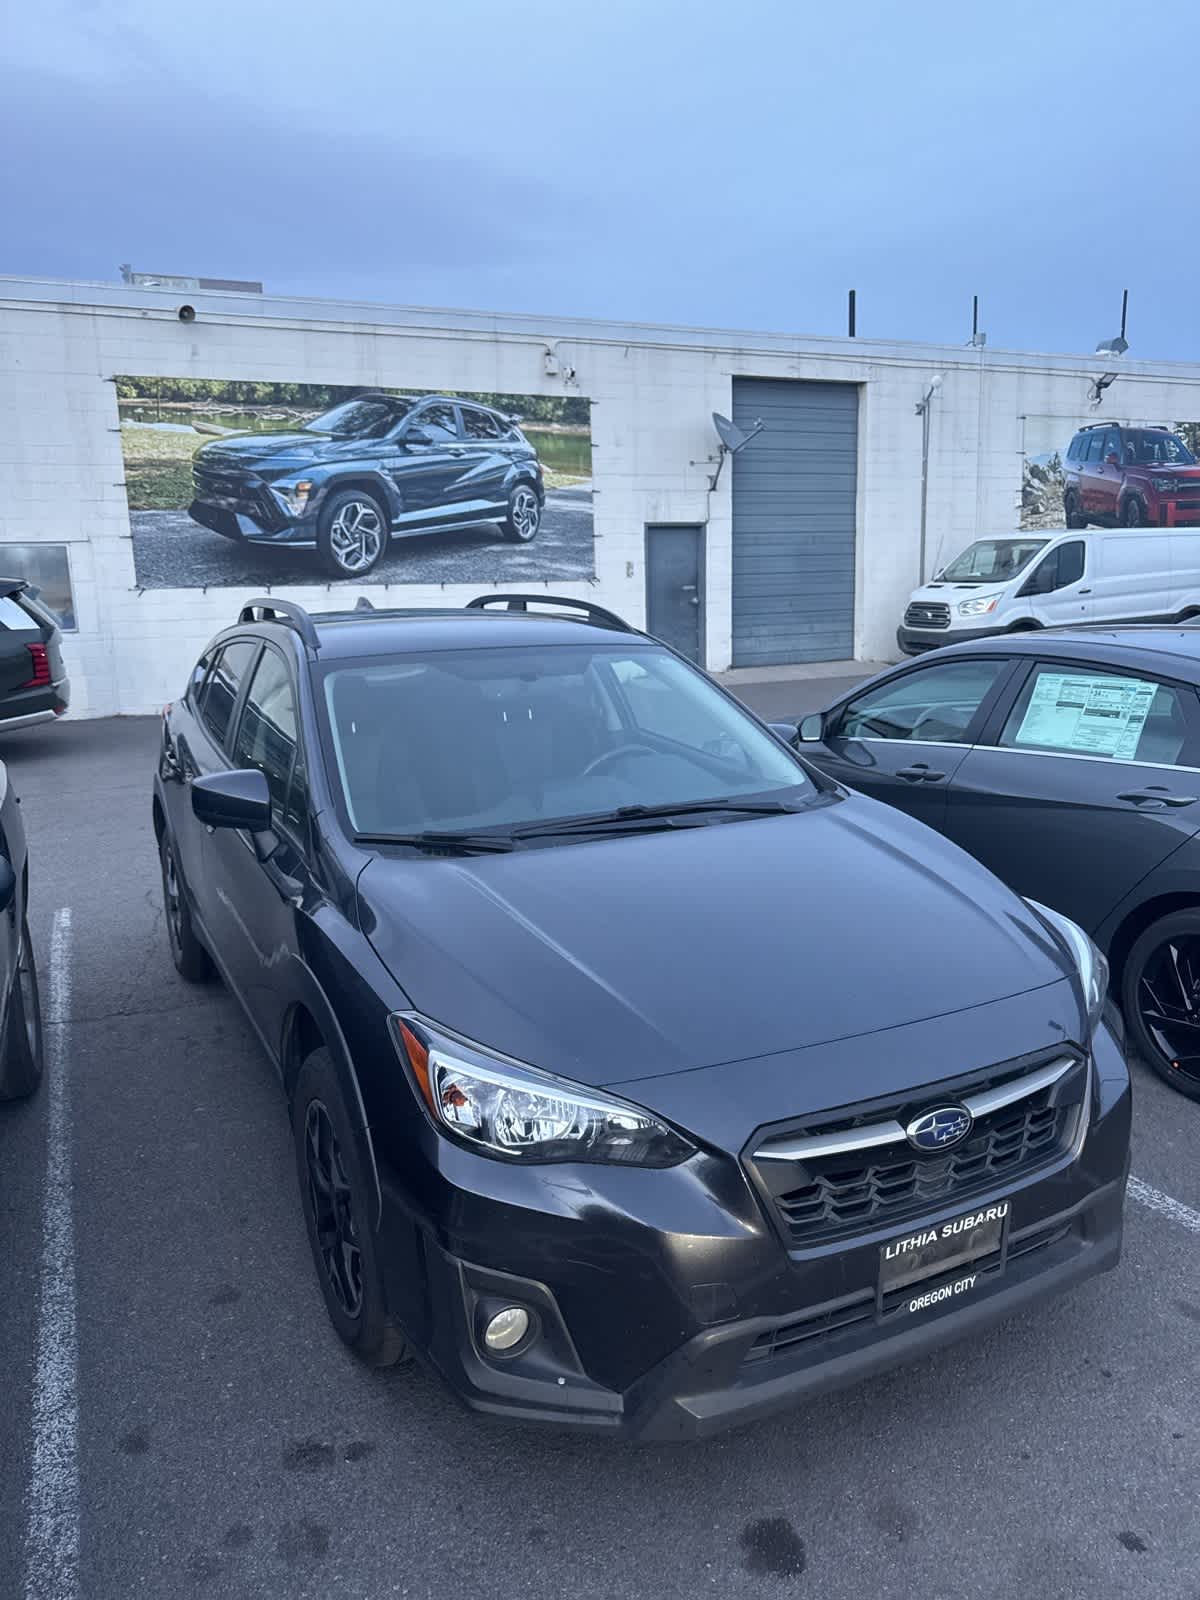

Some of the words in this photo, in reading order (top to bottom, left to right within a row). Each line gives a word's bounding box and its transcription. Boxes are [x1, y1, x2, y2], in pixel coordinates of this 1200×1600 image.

[886, 1230, 937, 1260] LITHIA
[941, 1203, 1008, 1238] SUBARU
[909, 1284, 952, 1313] OREGON
[954, 1275, 976, 1295] CITY
